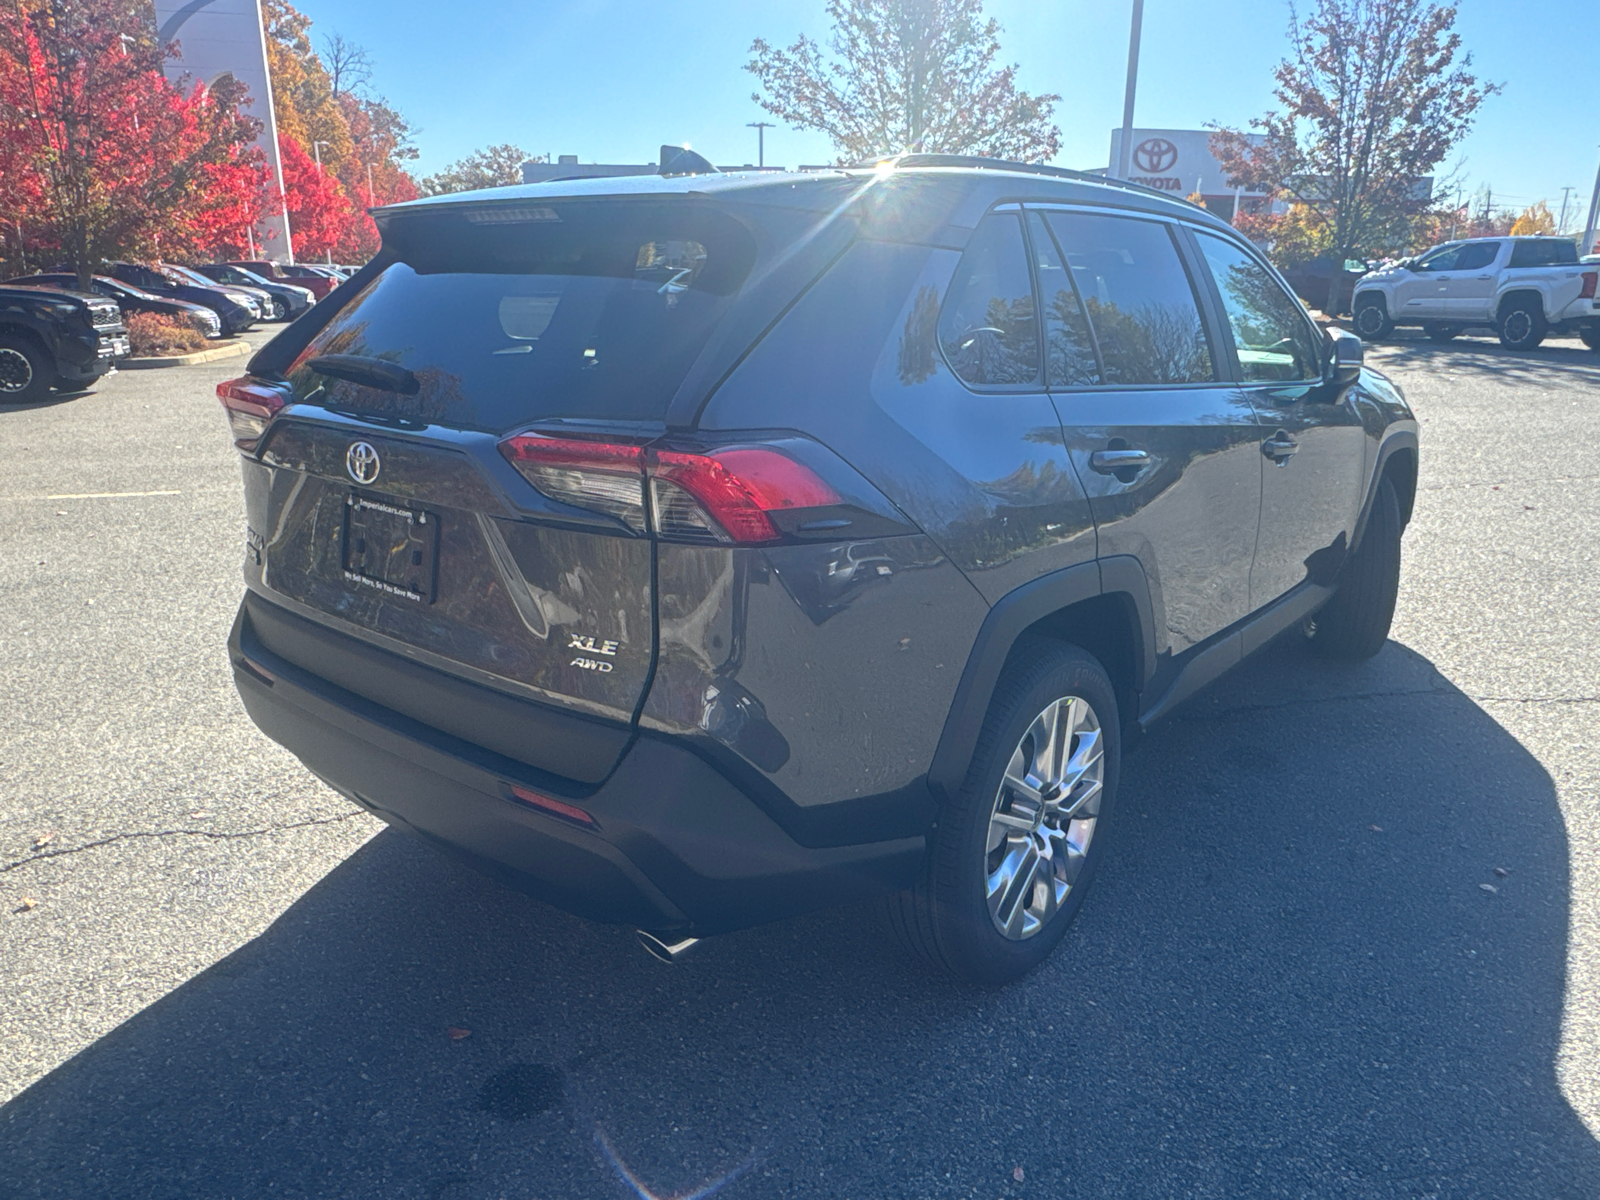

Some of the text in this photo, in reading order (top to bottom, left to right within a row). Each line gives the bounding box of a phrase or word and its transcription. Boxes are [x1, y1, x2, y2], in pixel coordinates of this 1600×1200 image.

[1127, 176, 1182, 191] YOTA
[352, 573, 362, 582] Sell
[375, 581, 383, 590] So
[383, 582, 393, 593] You
[393, 586, 406, 597] Save
[406, 590, 421, 602] More
[567, 632, 620, 656] XLE
[569, 657, 613, 673] AWD
